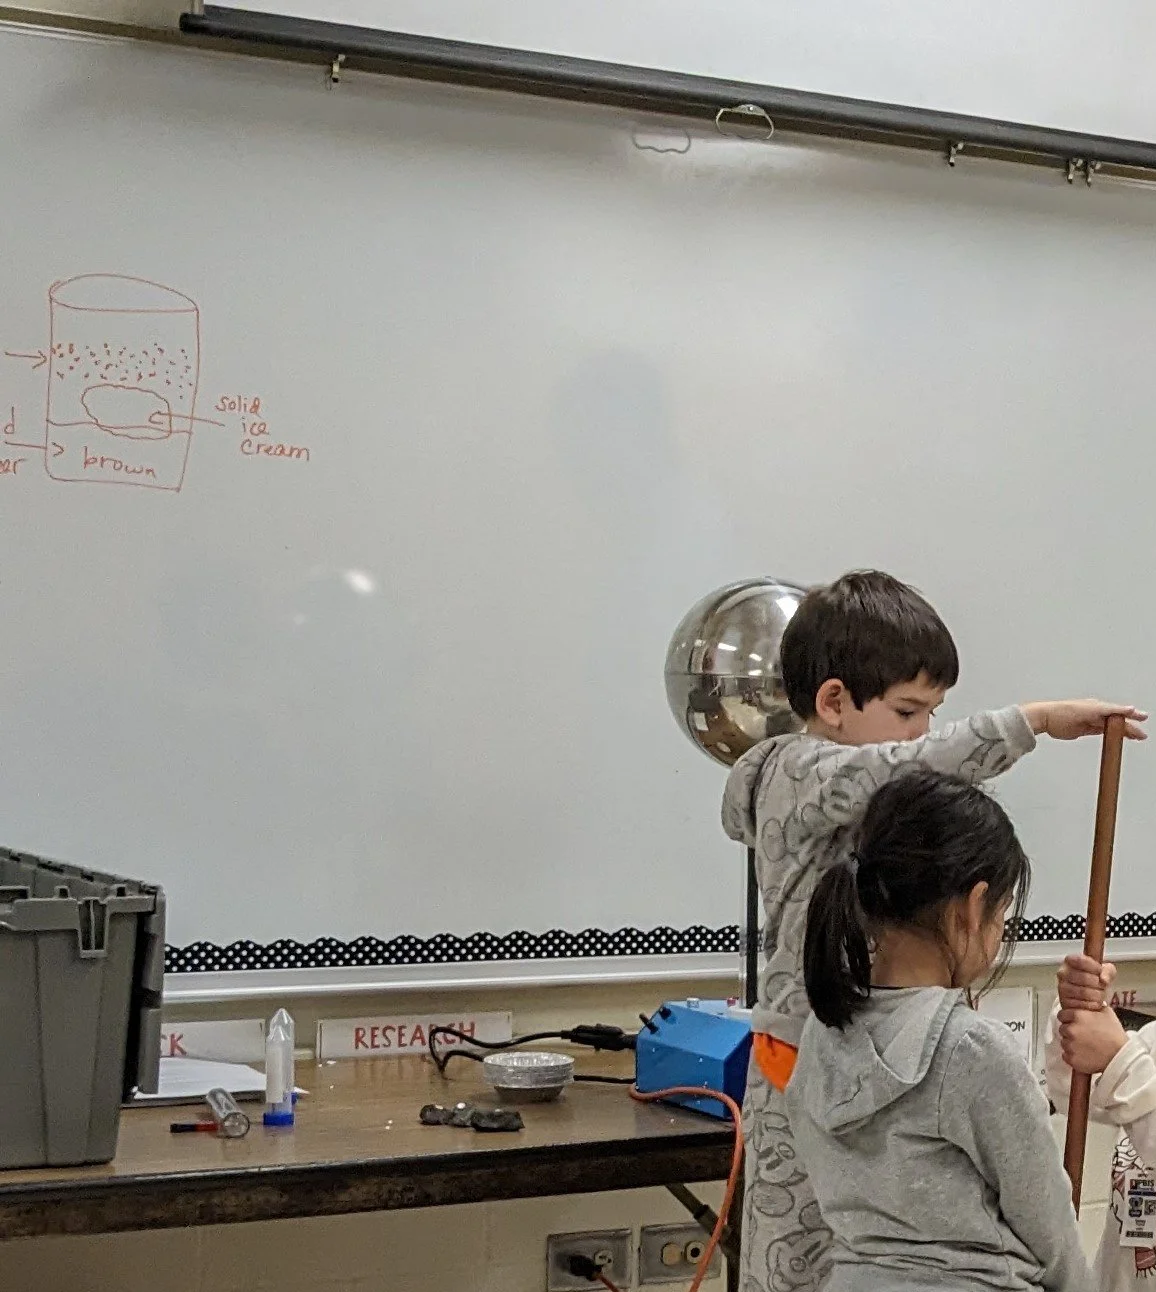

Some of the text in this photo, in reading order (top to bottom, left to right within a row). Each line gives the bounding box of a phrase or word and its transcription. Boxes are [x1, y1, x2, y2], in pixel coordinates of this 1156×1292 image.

[242, 416, 269, 436] ice
[83, 445, 156, 479] brown
[354, 1021, 476, 1050] RESEARCH
